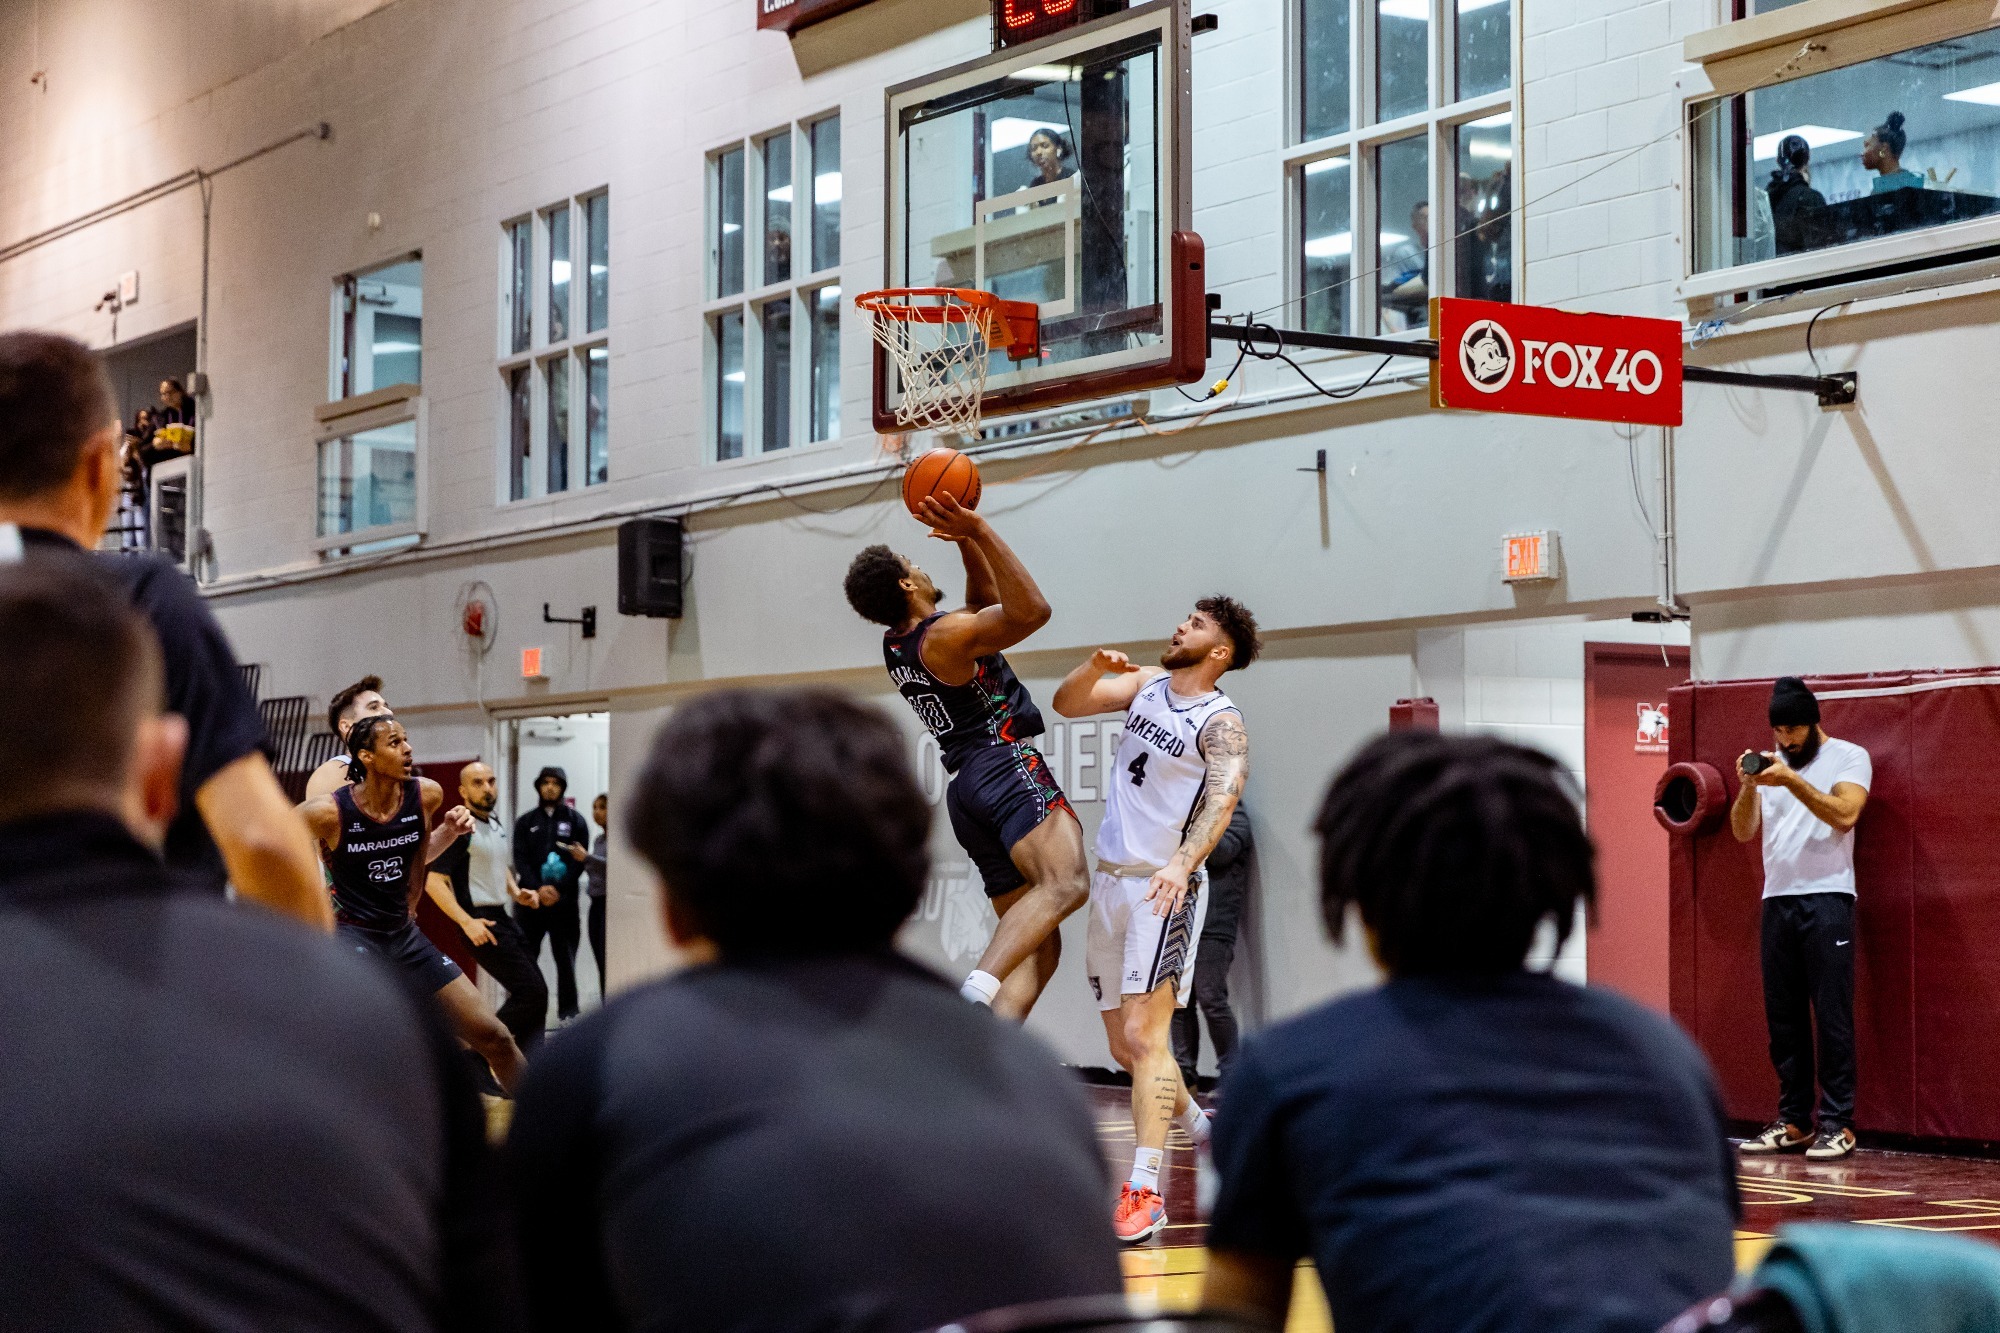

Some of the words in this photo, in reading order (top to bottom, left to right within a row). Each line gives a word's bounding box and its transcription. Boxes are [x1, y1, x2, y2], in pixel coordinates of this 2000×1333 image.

[1520, 339, 1604, 390] FOX
[1604, 348, 1663, 396] 40
[1508, 537, 1541, 576] EXIT
[1124, 710, 1186, 758] LAKEHEAD
[1127, 751, 1150, 788] 4
[347, 830, 420, 853] MARAUDERS
[367, 855, 404, 883] 22
